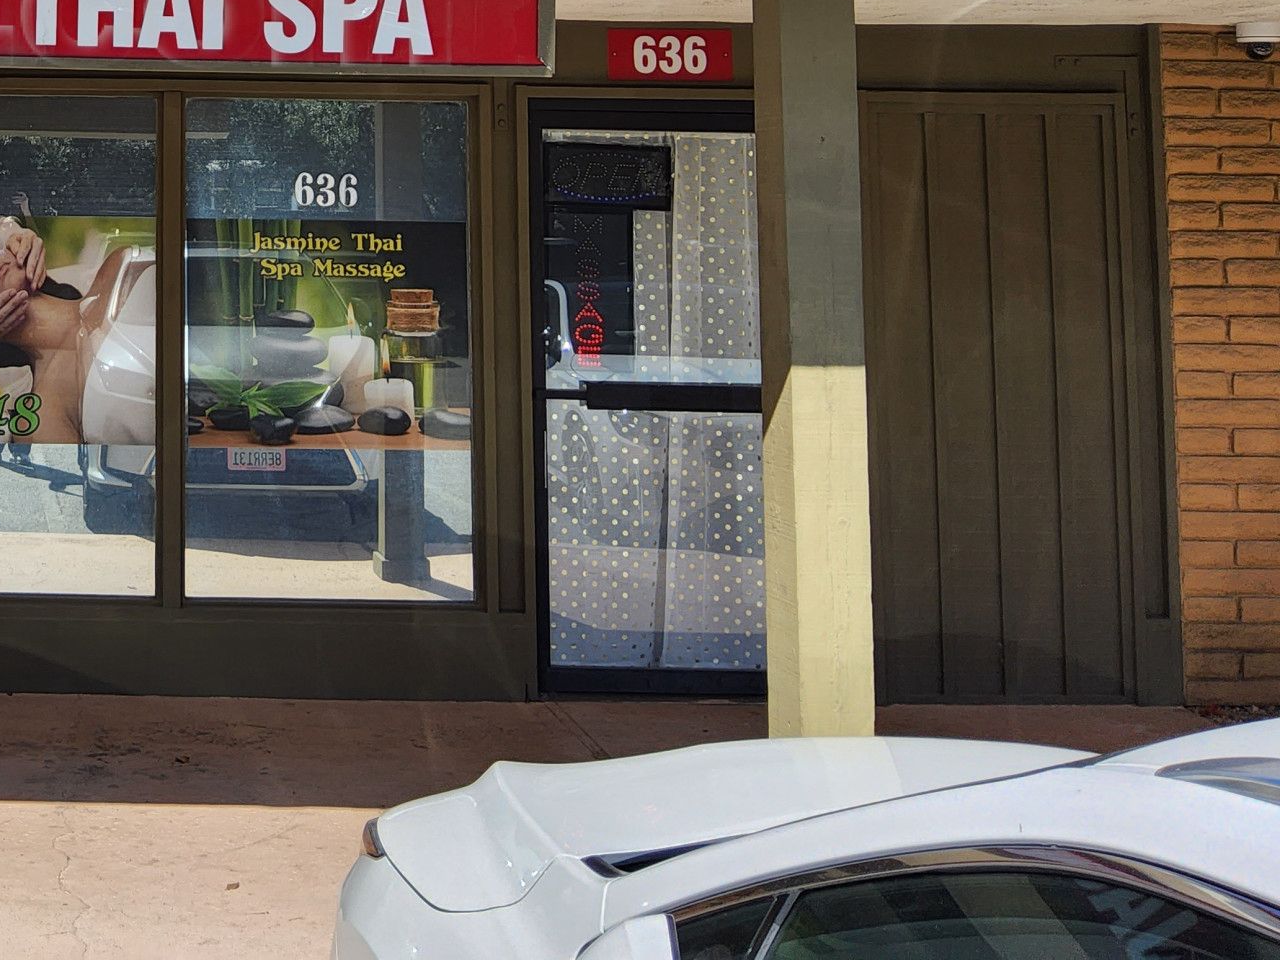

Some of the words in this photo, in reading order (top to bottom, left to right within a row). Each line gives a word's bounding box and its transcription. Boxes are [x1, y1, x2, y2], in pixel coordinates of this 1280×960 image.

[632, 35, 708, 75] 636
[294, 171, 359, 208] 636
[552, 160, 663, 192] OPEN
[250, 231, 341, 254] Jasmine
[351, 232, 404, 254] Thai
[260, 258, 303, 281] Spa
[313, 258, 407, 282] Massage
